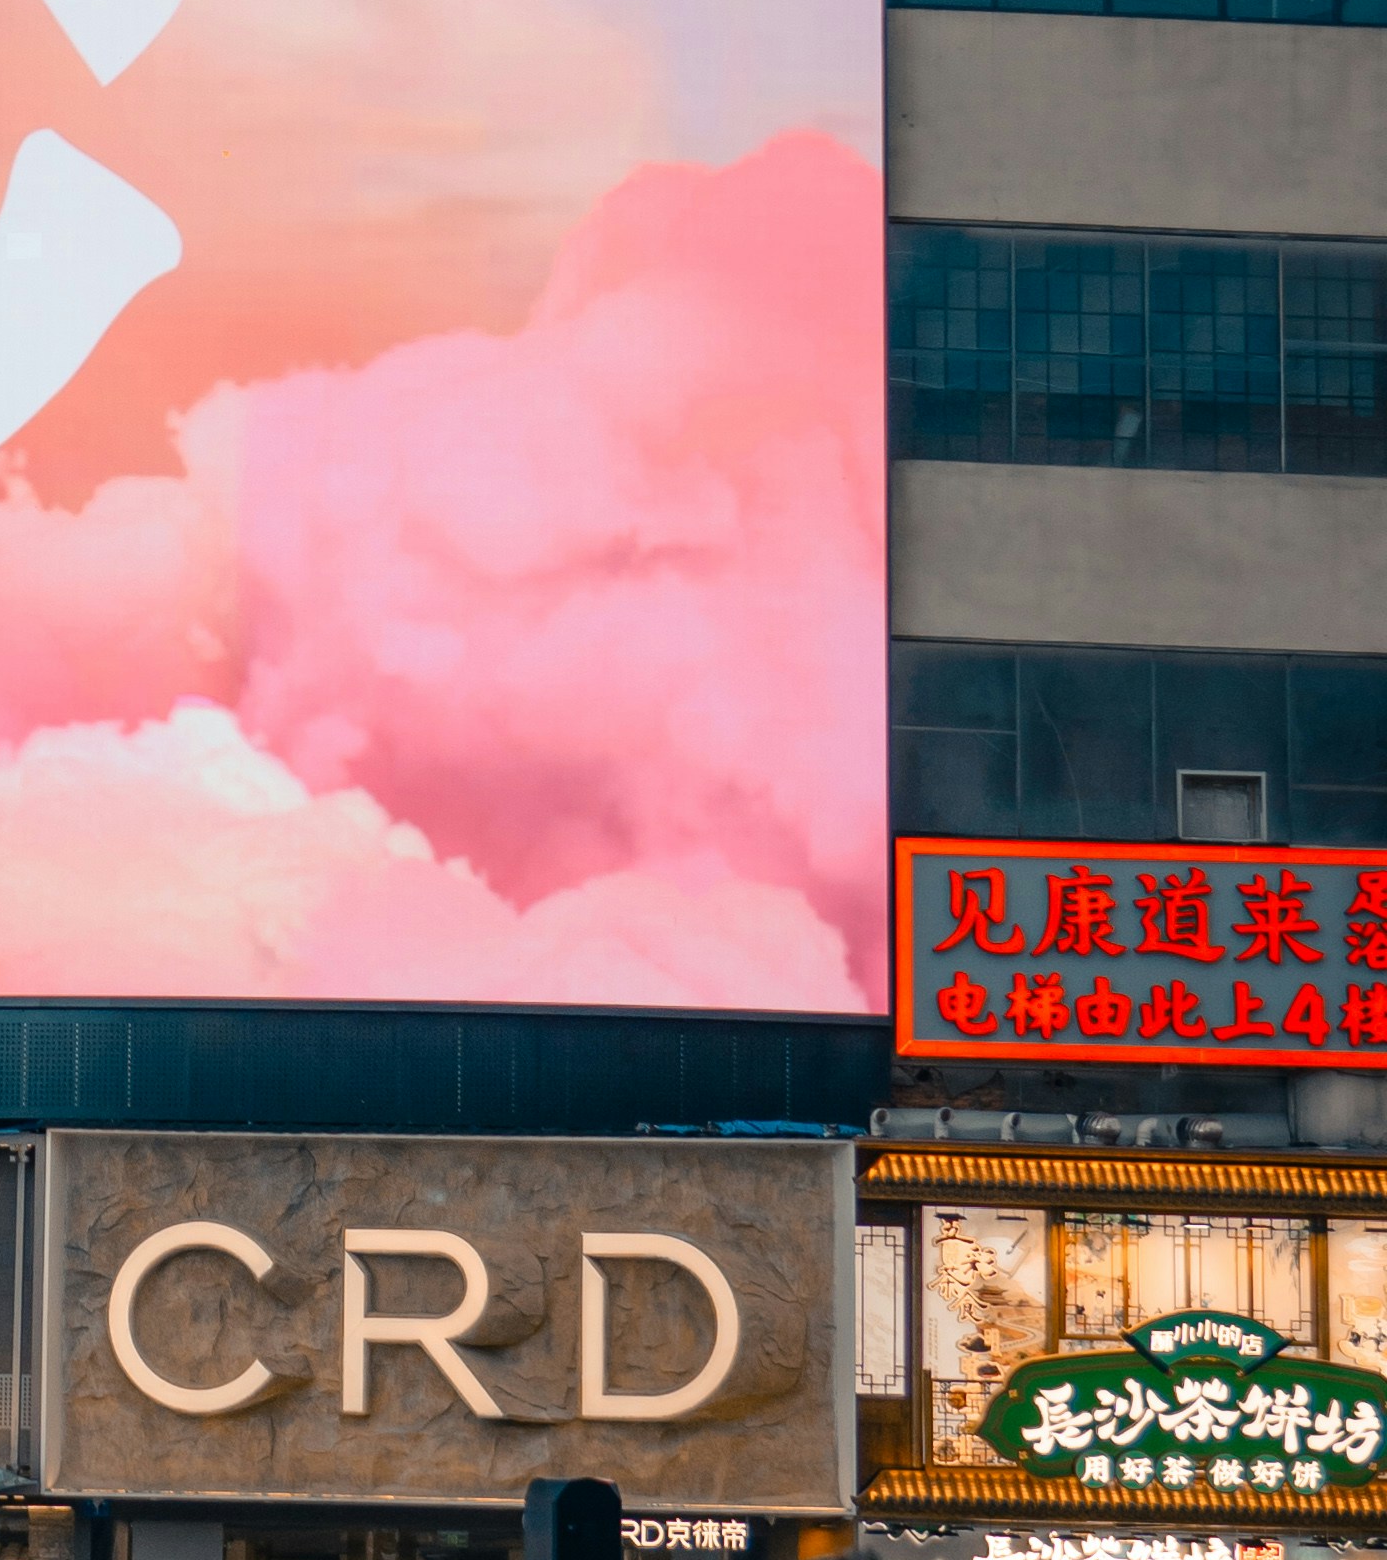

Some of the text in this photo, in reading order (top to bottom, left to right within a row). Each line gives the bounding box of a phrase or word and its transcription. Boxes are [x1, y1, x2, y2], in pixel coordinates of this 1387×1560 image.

[932, 864, 1325, 965] 见康道莱
[936, 970, 1387, 1048] 电梯由此上4楼
[107, 1220, 741, 1423] CRD
[1150, 1318, 1265, 1357] 酥小小的店
[1020, 1376, 1382, 1465] 長沙茶饼坊
